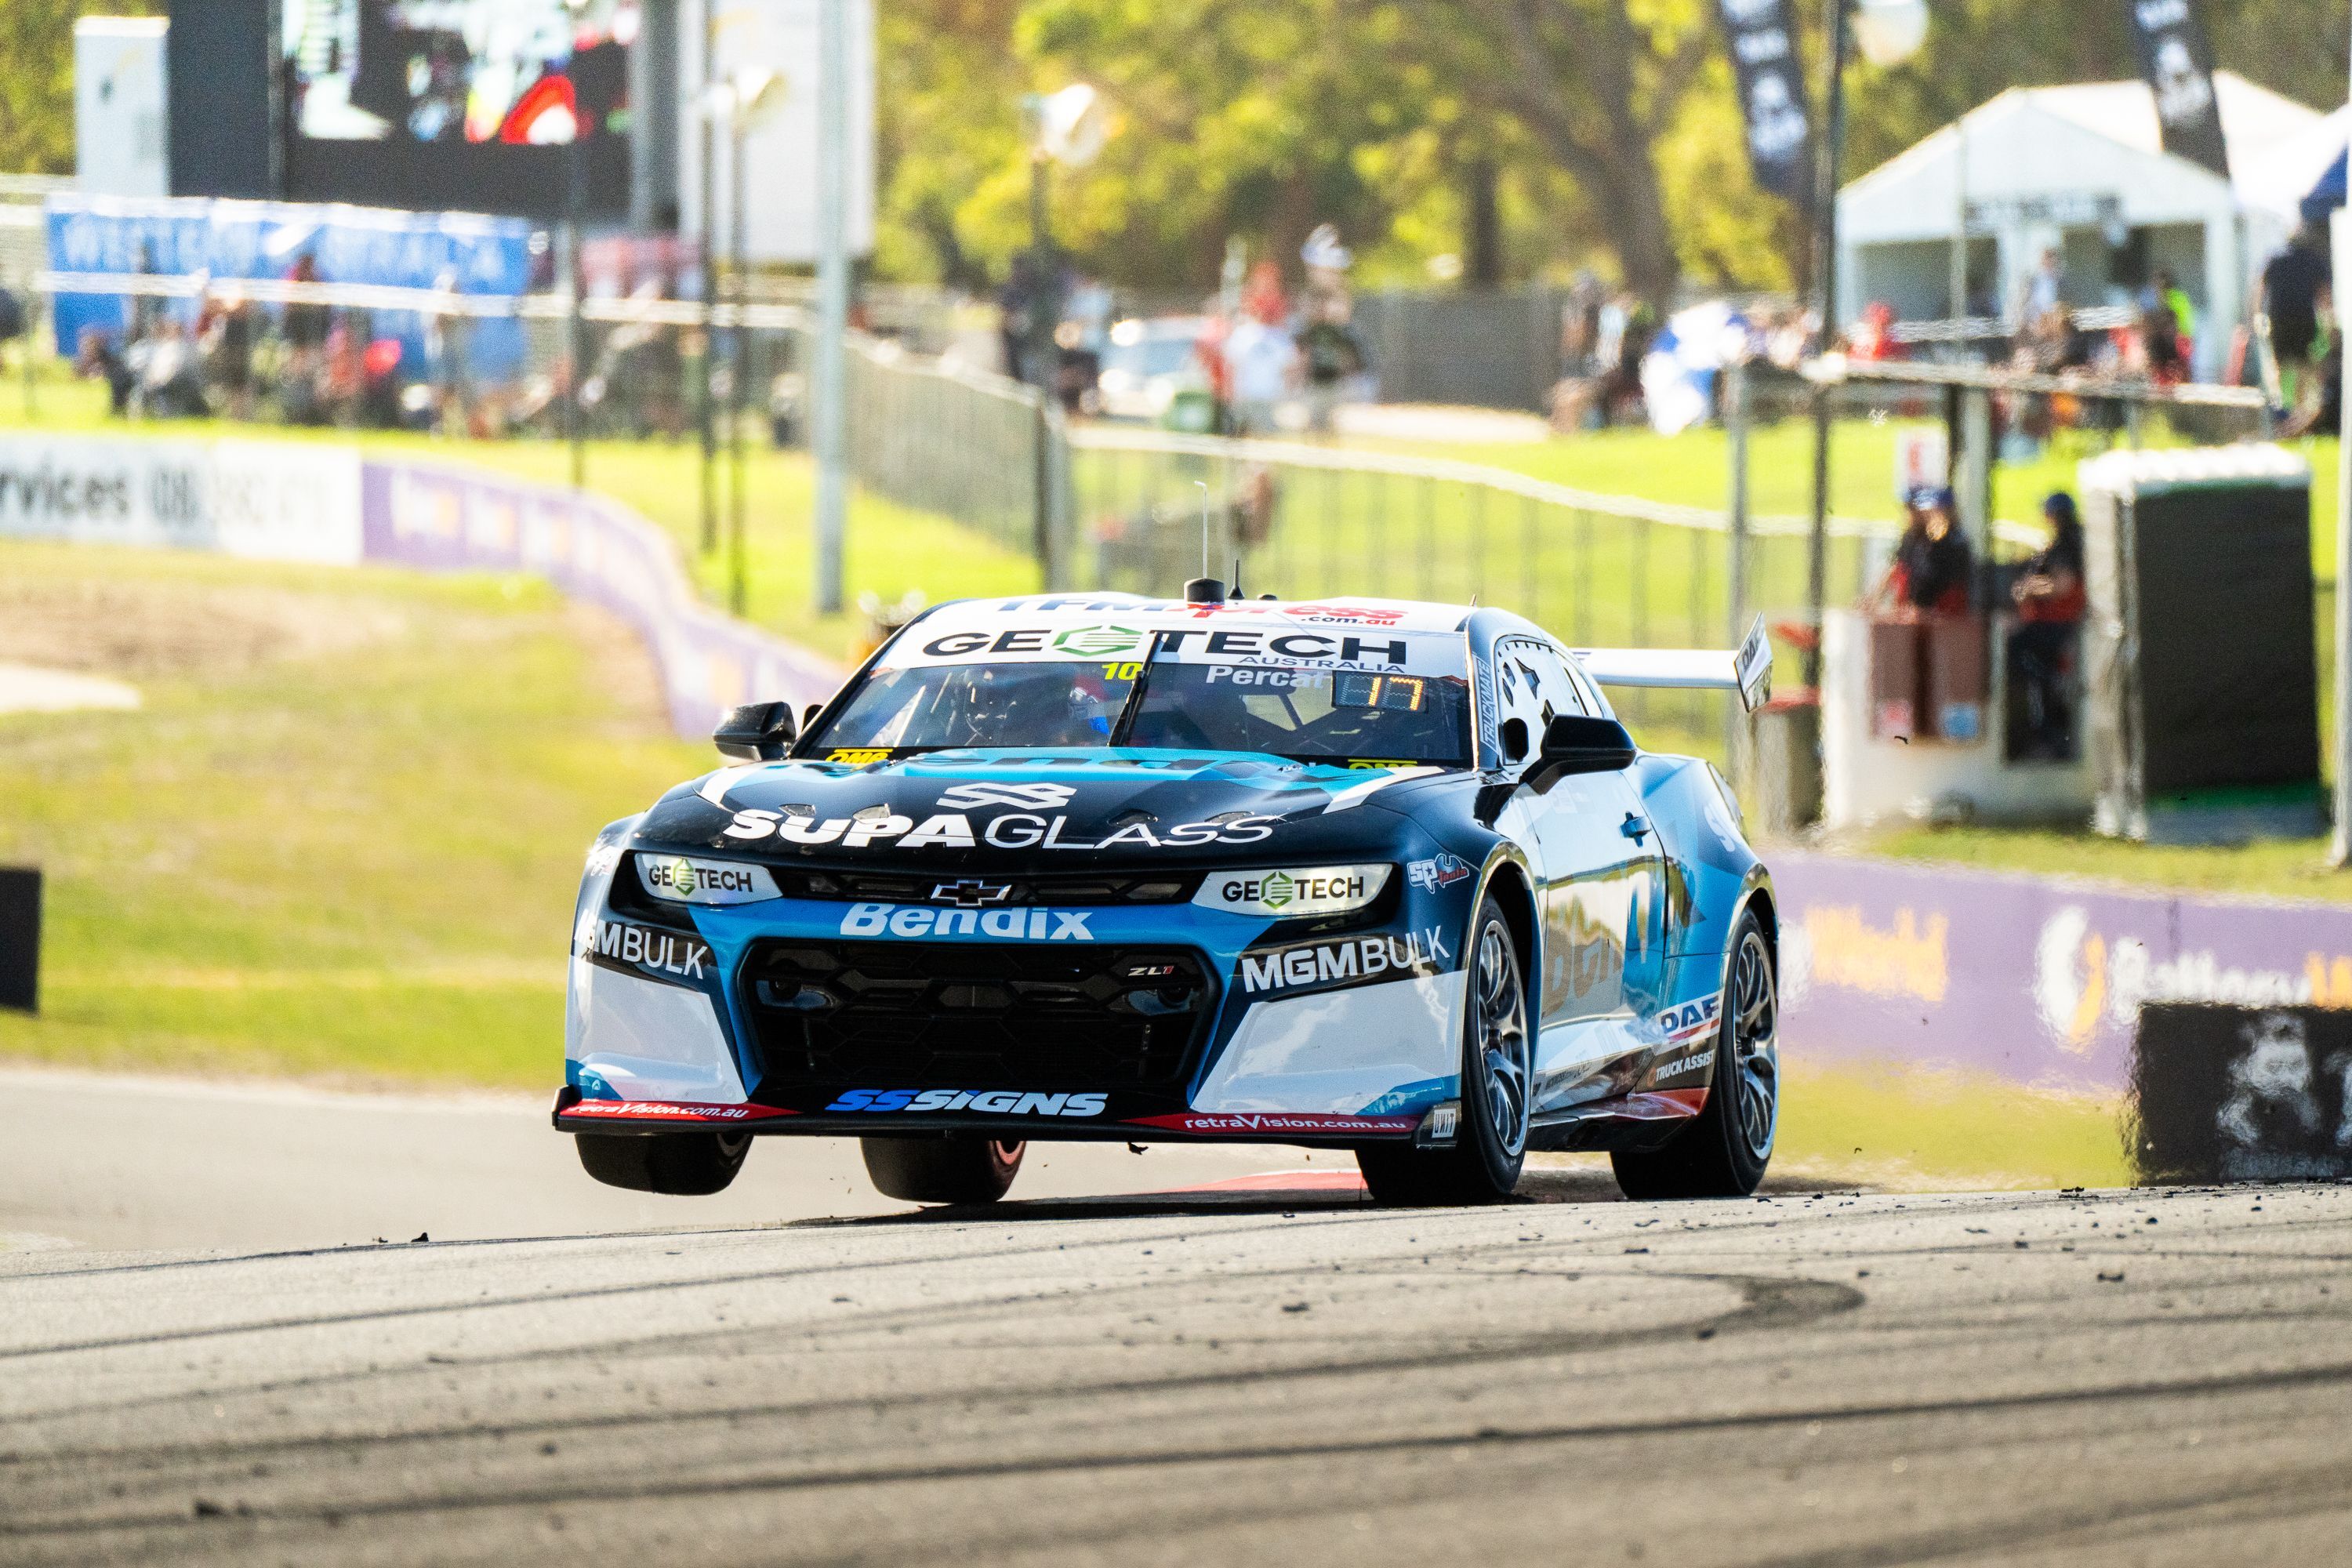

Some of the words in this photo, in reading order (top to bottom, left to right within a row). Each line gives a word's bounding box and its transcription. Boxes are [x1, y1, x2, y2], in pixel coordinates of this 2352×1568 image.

[1102, 662, 1143, 681] 10
[1206, 665, 1324, 689] Percat
[1239, 656, 1406, 673] AUSTRALIA
[1367, 676, 1424, 712] 17
[840, 902, 1095, 942] Bendix
[576, 909, 708, 980] MBULK
[1241, 925, 1450, 993] MGMBULK
[1127, 965, 1174, 977] ZL1
[1660, 995, 1719, 1035] DAF
[1655, 1062, 1683, 1083] TRUCK
[1683, 1049, 1715, 1073] ASSIST
[1185, 1114, 1407, 1130] retraVision.com.au
